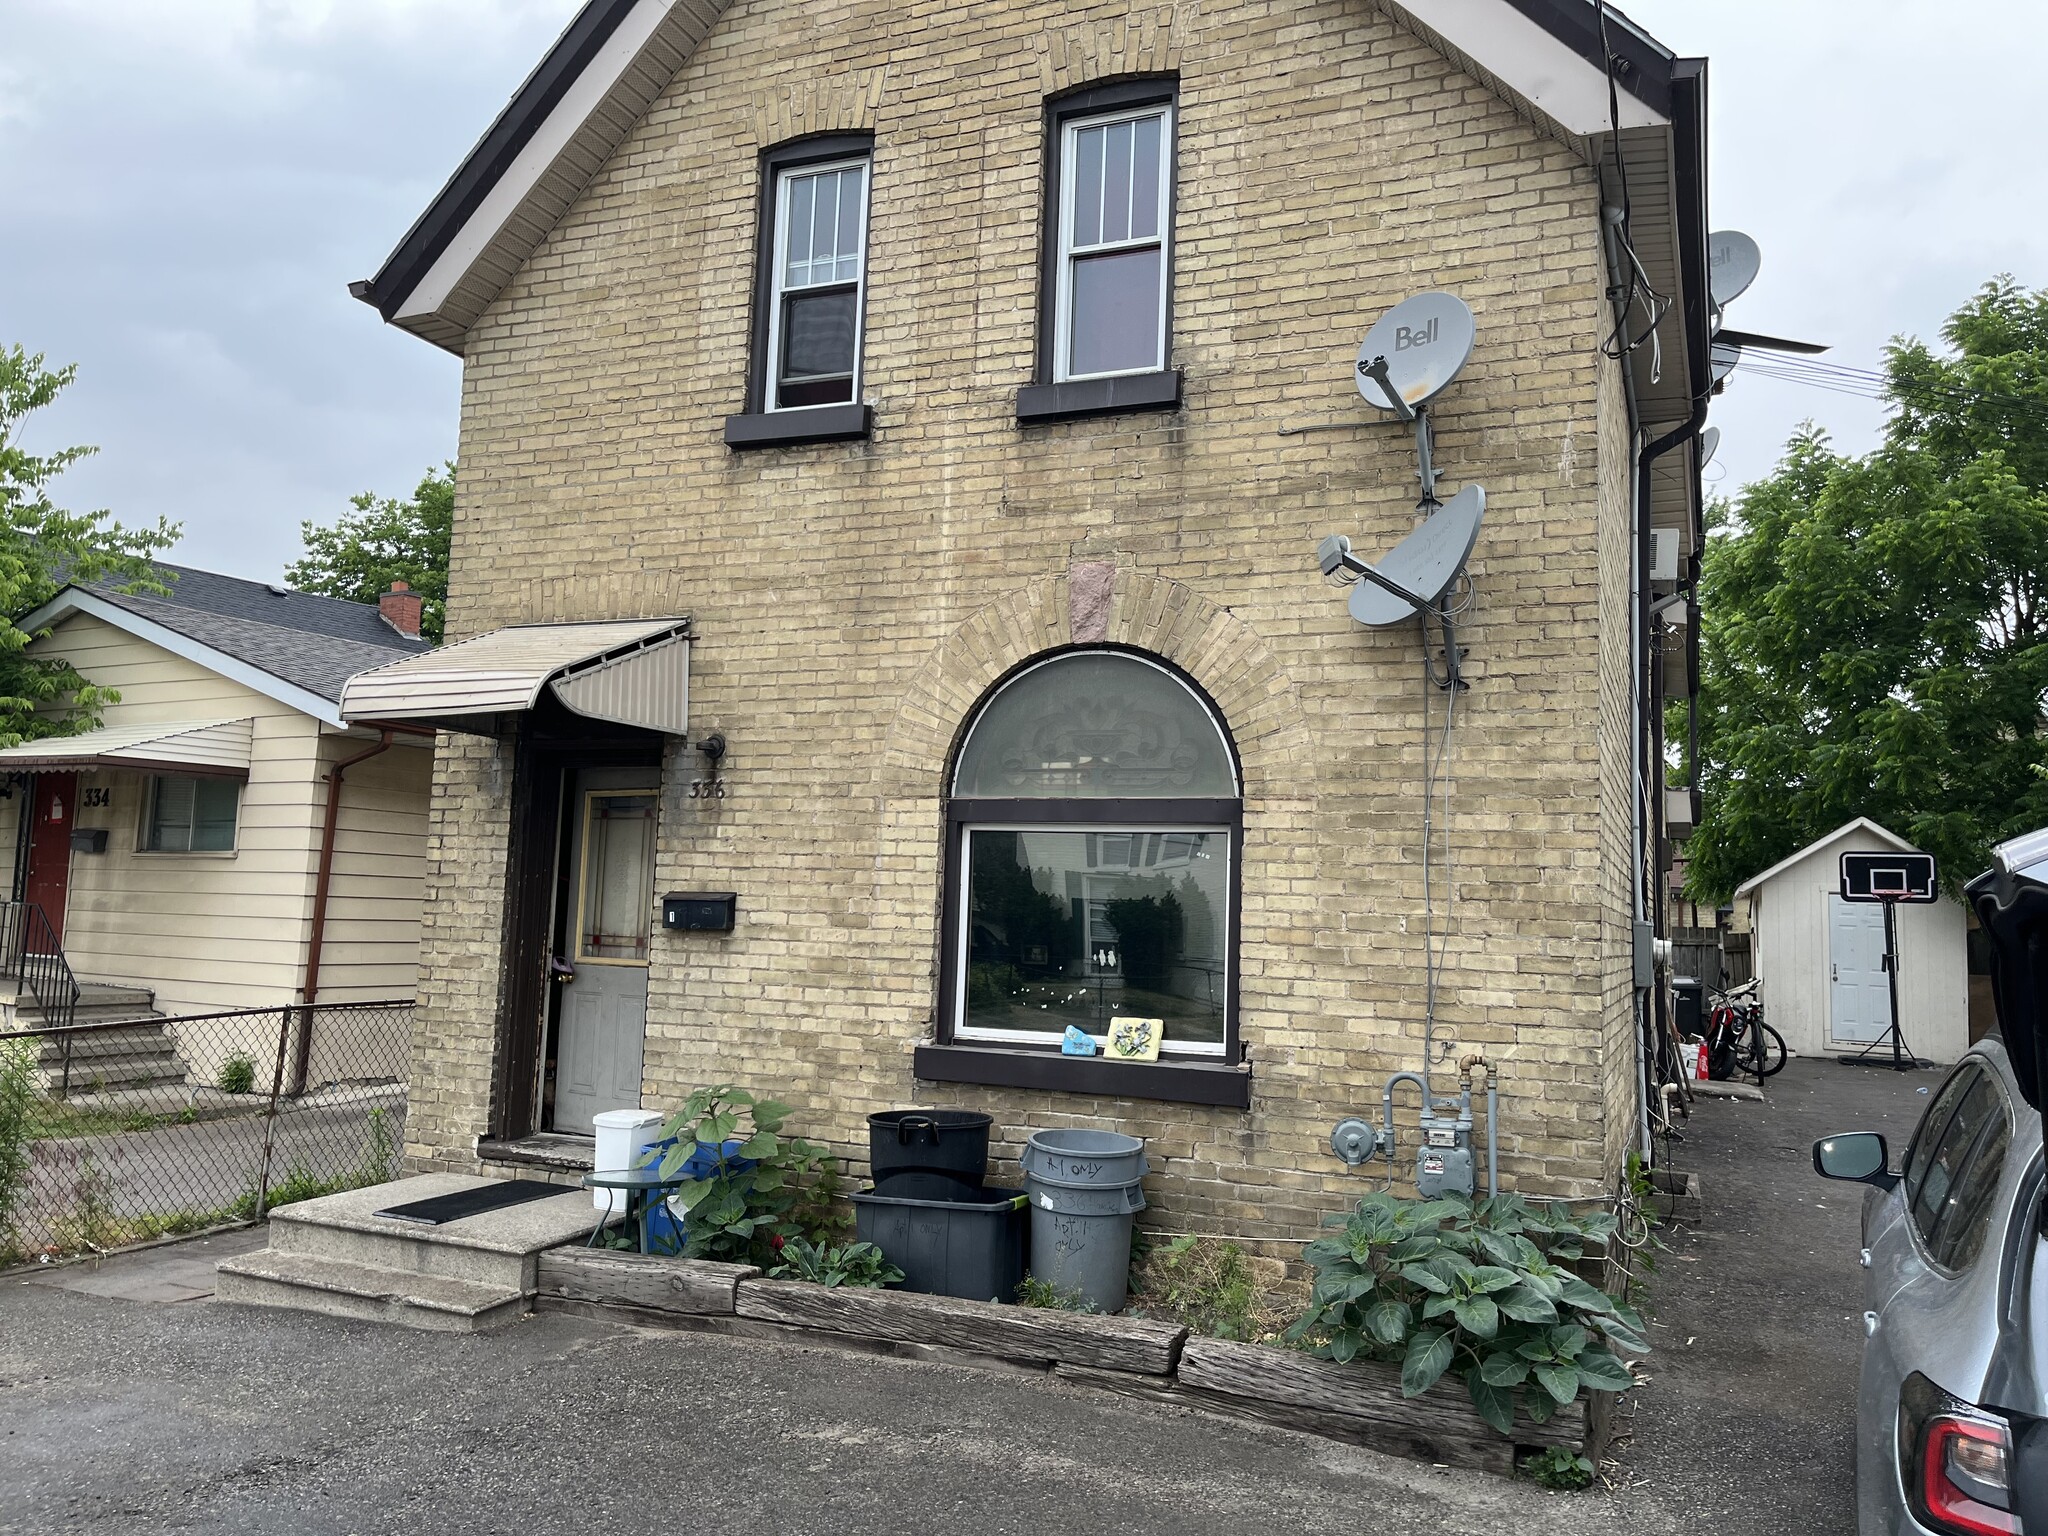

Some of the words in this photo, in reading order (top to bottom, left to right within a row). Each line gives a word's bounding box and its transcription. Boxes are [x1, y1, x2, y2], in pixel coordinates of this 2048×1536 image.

[1710, 247, 1730, 267] ell
[1395, 317, 1439, 352] Bell
[83, 787, 110, 807] 334
[1071, 1162, 1103, 1179] ONLY
[1051, 1190, 1086, 1211] 336
